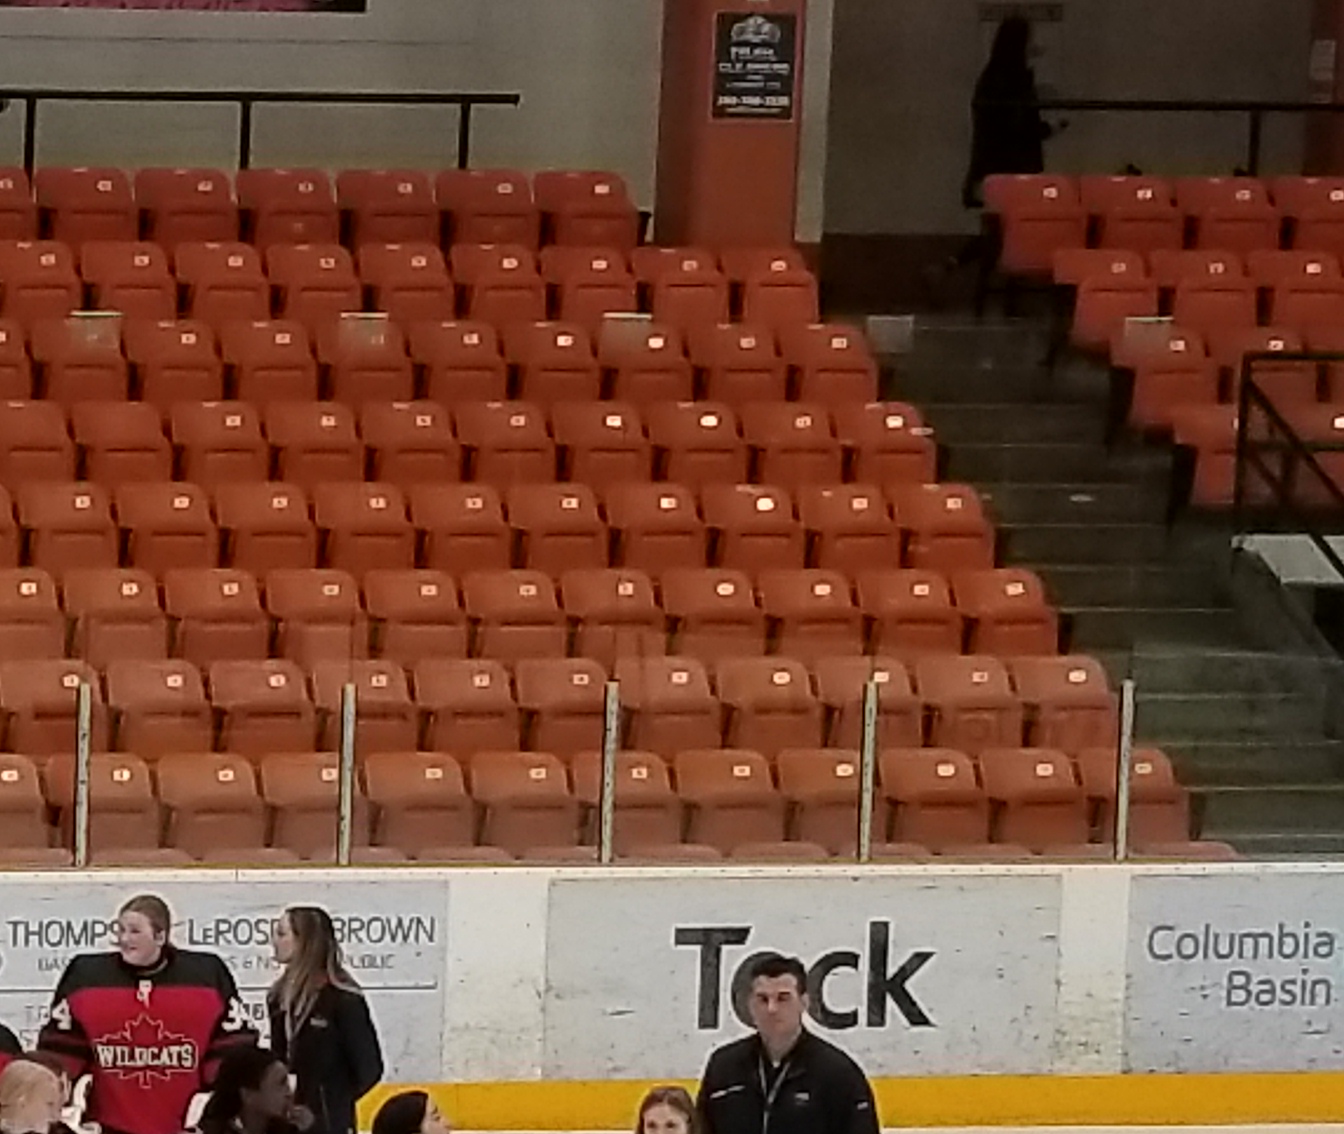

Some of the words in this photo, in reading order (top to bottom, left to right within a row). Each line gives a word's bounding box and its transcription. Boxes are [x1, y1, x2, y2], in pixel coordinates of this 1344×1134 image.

[336, 915, 438, 944] BROWN
[1148, 921, 1336, 961] Columbia
[1225, 967, 1331, 1007] Basin
[97, 1044, 193, 1068] WILDCATS
